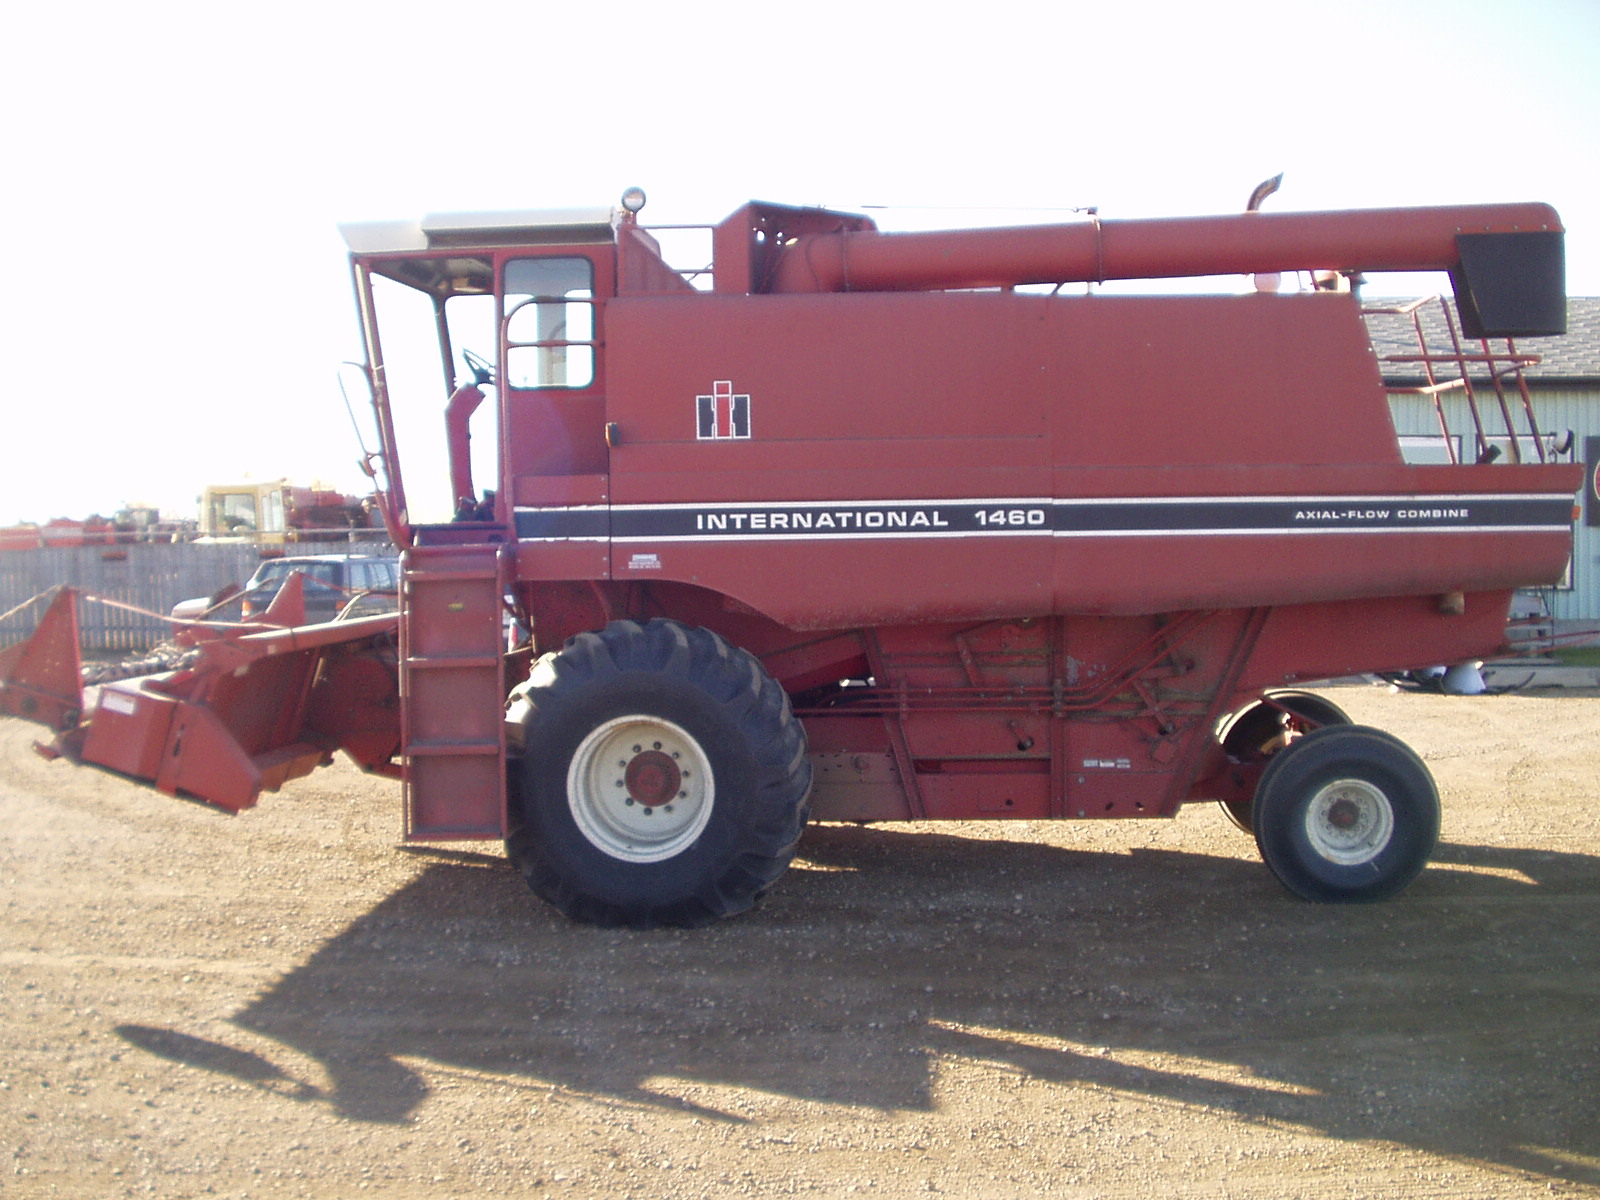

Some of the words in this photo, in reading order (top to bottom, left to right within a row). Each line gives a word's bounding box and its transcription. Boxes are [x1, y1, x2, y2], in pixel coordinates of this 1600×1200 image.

[697, 510, 949, 530] INTERNATIONAL
[974, 509, 1045, 526] 1460
[1295, 509, 1390, 520] AXIAL-FLOW
[1397, 508, 1469, 519] COMBINE
